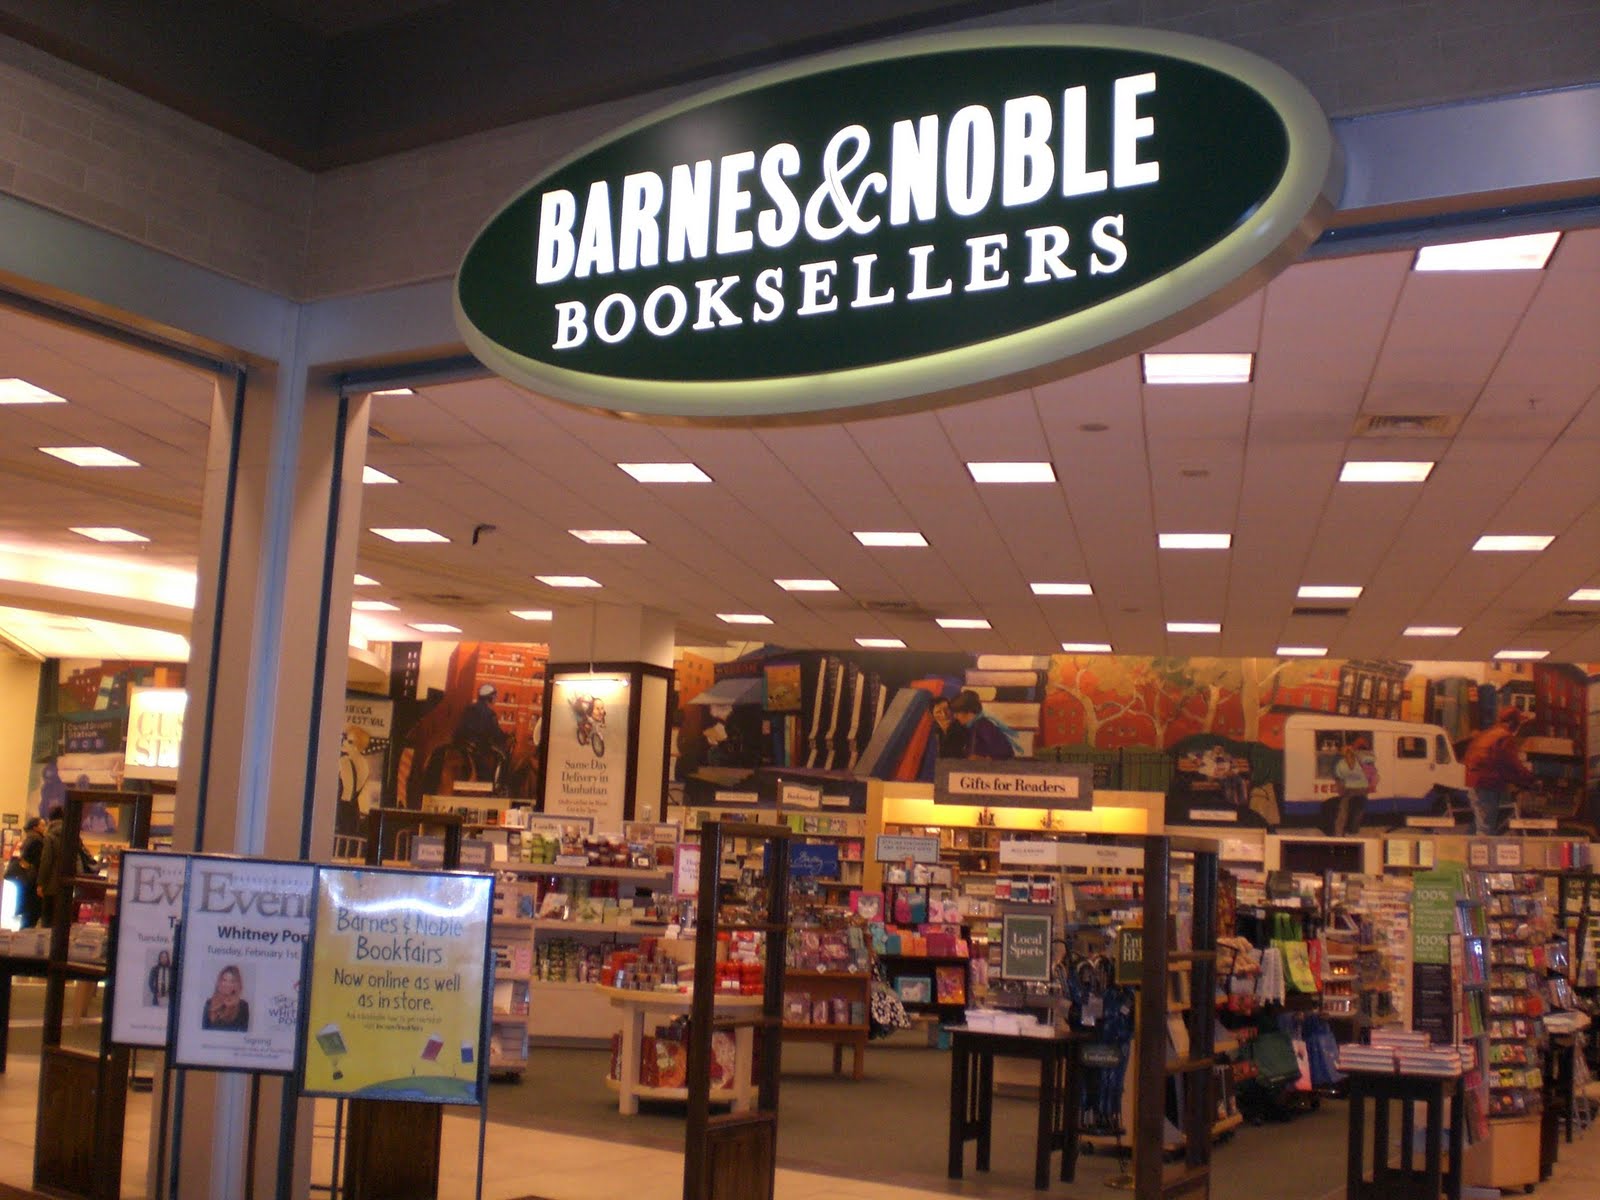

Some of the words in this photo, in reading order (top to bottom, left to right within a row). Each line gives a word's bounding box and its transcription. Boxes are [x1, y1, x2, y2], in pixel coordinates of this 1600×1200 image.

[552, 214, 1129, 350] BOOKSELLERS
[565, 760, 590, 769] Same
[591, 759, 607, 773] Day
[561, 771, 598, 783] Delivery
[599, 774, 609, 783] in
[562, 784, 608, 795] Manhattan
[959, 776, 991, 791] Gifts
[993, 776, 1013, 790] for
[1015, 778, 1066, 793] Readers
[1416, 889, 1449, 900] 100%
[337, 907, 398, 934] Barnes
[403, 911, 411, 936] &
[416, 913, 464, 937] Noble
[217, 925, 279, 944] Whitney
[1013, 932, 1042, 944] Local
[1416, 935, 1448, 946] 100%
[207, 946, 244, 958] Tuesday,
[245, 948, 283, 960] February
[356, 935, 443, 964] Bookfairs
[1010, 946, 1044, 959] Sports
[334, 968, 364, 986] Now
[368, 970, 410, 989] online
[414, 977, 429, 991] as
[434, 975, 461, 992] well
[357, 994, 374, 1008] as
[378, 991, 391, 1009] in
[394, 993, 434, 1012] store.
[243, 1035, 272, 1047] Signing
